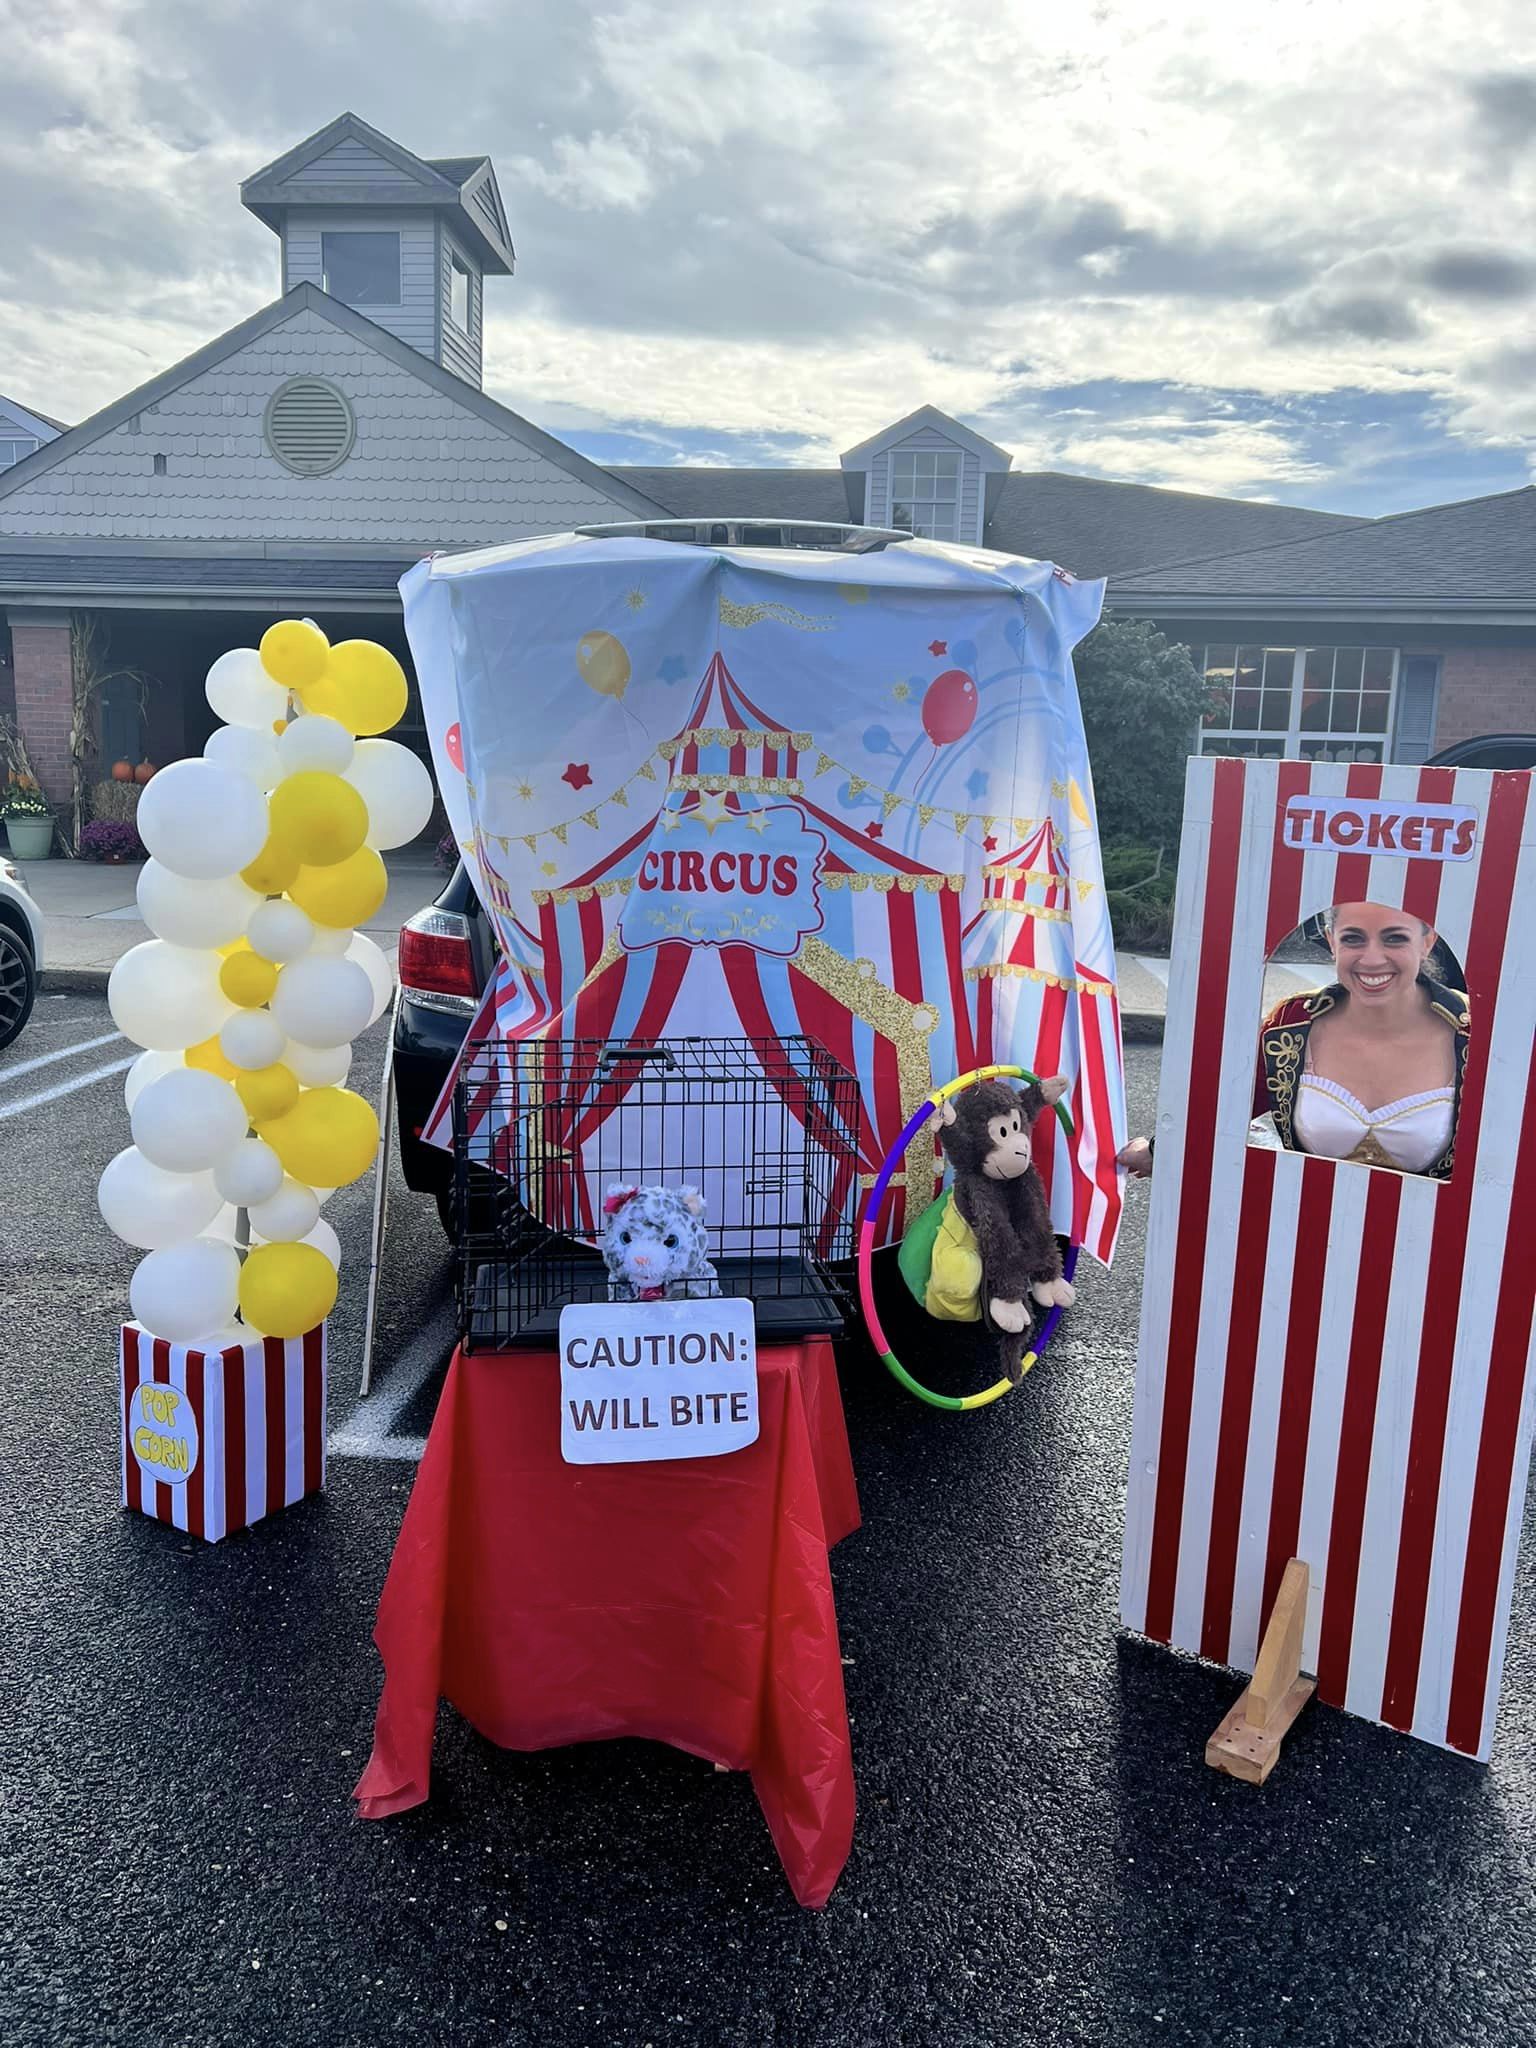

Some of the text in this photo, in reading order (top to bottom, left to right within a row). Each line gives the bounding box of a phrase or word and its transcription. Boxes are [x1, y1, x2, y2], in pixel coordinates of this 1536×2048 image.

[1286, 807, 1477, 856] TICKETS
[638, 850, 798, 896] CIRCUS
[566, 1331, 748, 1369] CAUTION:
[140, 1385, 180, 1428] POP
[569, 1392, 749, 1431] WILL BITE
[134, 1425, 189, 1473] CORN
